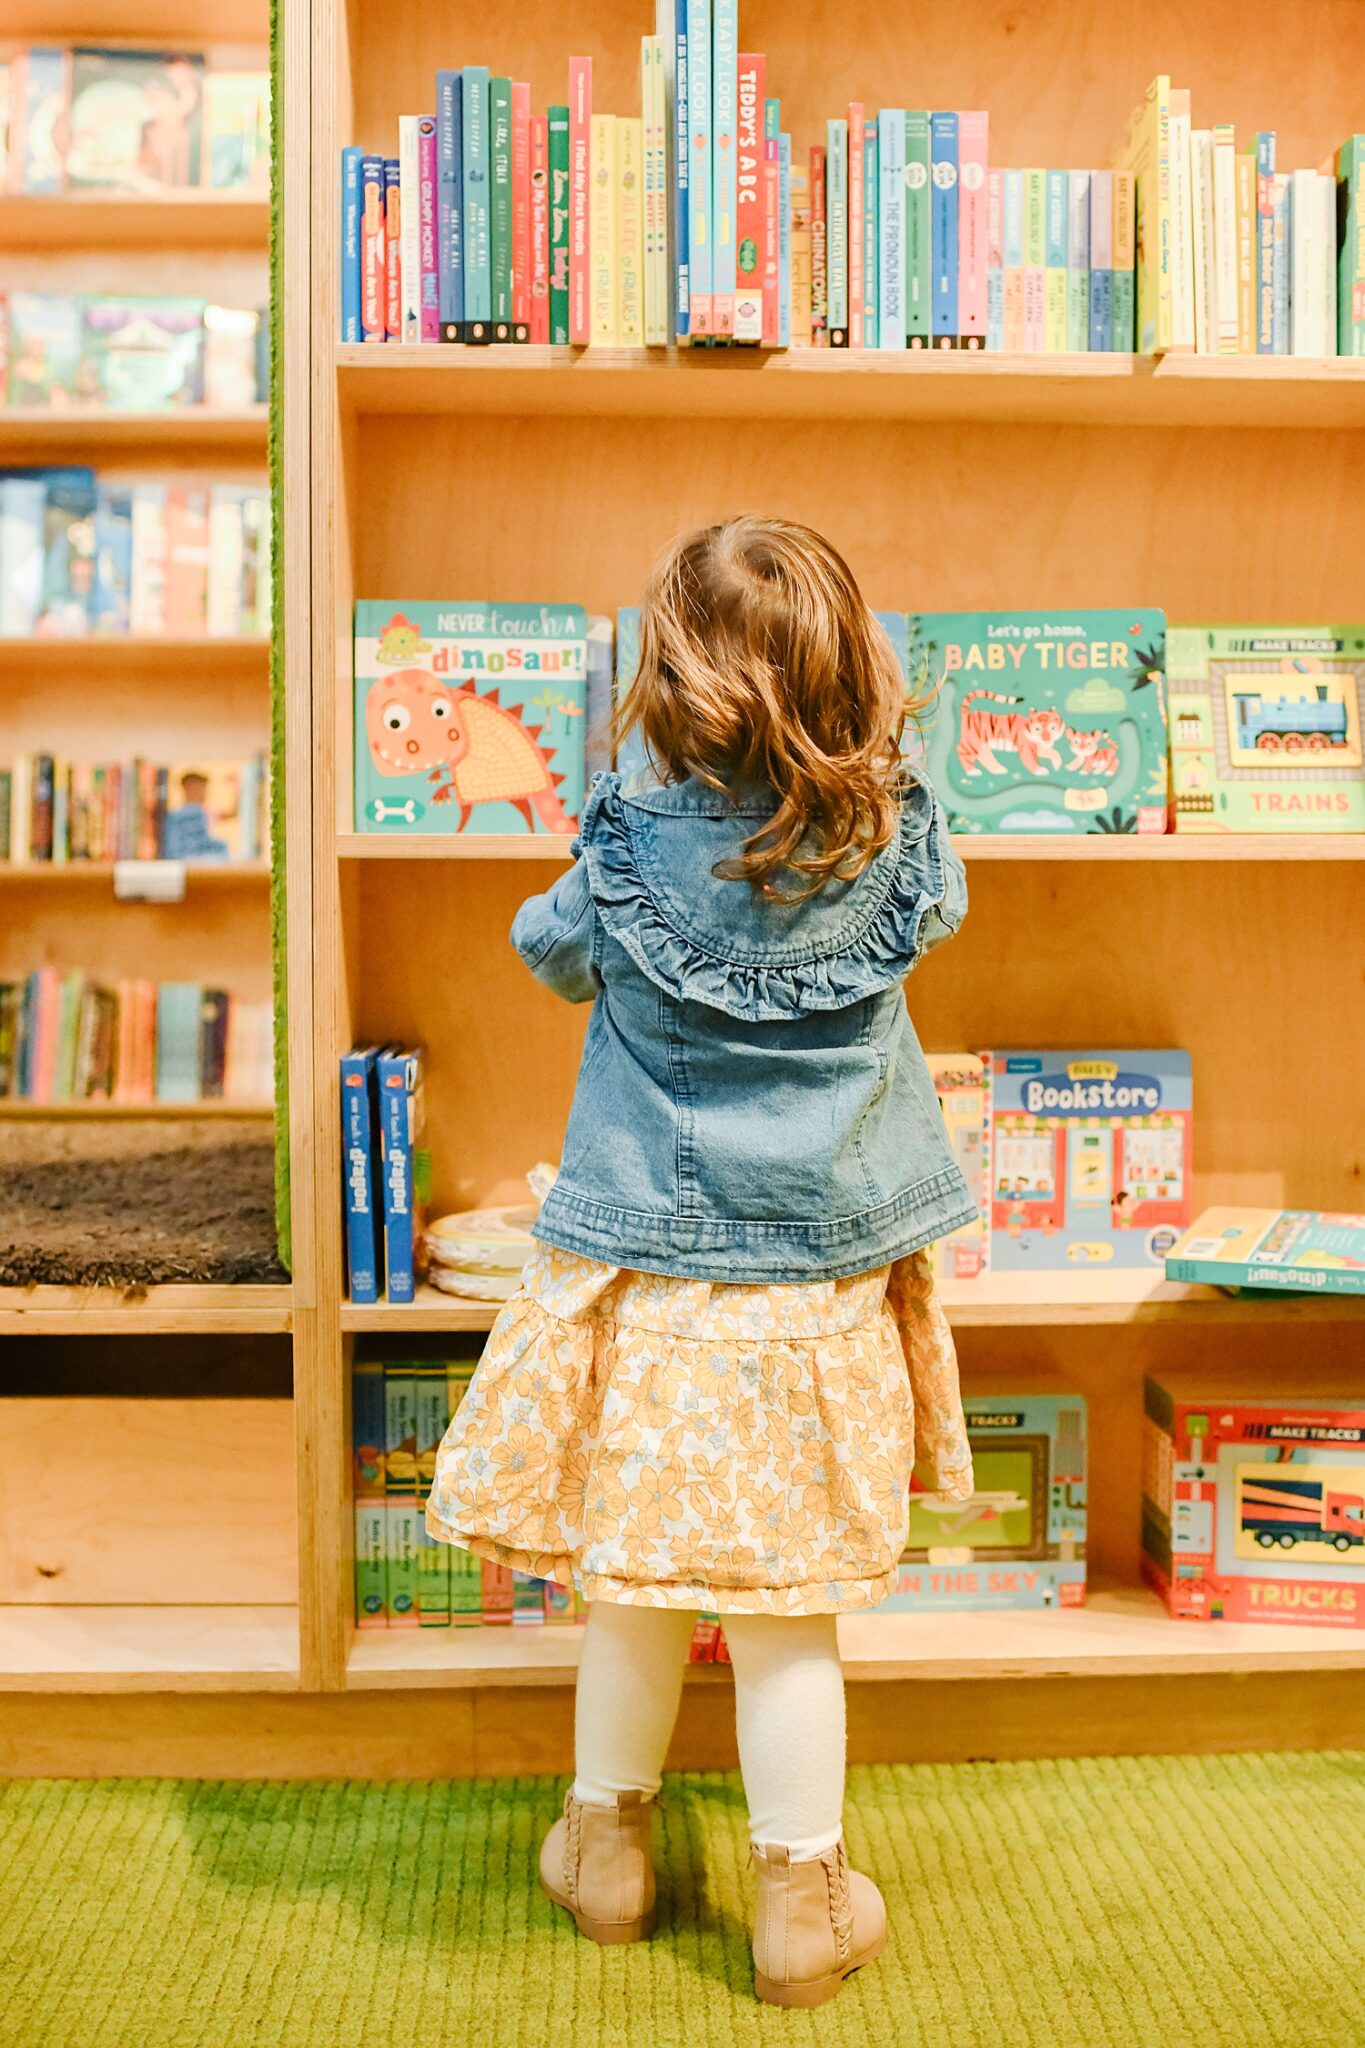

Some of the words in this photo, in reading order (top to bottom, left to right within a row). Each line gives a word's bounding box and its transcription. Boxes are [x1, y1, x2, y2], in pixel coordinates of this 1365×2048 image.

[692, 72, 705, 126] LOOK!
[718, 72, 732, 126] LOOK!
[739, 70, 757, 148] TEDDY'S
[1160, 106, 1168, 142] HAPPY
[574, 146, 585, 170] Find
[573, 172, 585, 190] My
[574, 192, 585, 217] First
[885, 202, 899, 221] THE
[574, 219, 585, 255] Words
[885, 223, 899, 284] PRONOUN
[812, 220, 826, 316] CHINATOWN
[885, 286, 899, 319] BOOK
[437, 614, 484, 632] NEVER
[490, 608, 563, 636] touch
[565, 616, 575, 632] A
[987, 625, 1020, 637] Let's
[1023, 626, 1041, 639] go
[945, 643, 1027, 670] BABY
[1033, 641, 1129, 669] TIGER
[1253, 640, 1289, 651] MAKE
[1291, 640, 1337, 651] TRACKS
[432, 647, 582, 673] dinosaur!
[1250, 792, 1350, 812] TRAINS
[1027, 1082, 1159, 1113] Bookstore
[349, 1148, 369, 1214] dragon!
[389, 1149, 409, 1215] dragon!
[1247, 1267, 1326, 1287] dinosaur!
[972, 1415, 1018, 1426] TRACKS
[1270, 1426, 1309, 1438] MAKE
[1310, 1427, 1361, 1441] TRACKS
[928, 1573, 980, 1594] THE
[987, 1571, 1040, 1593] SKY
[1247, 1583, 1357, 1611] TRUCKS
